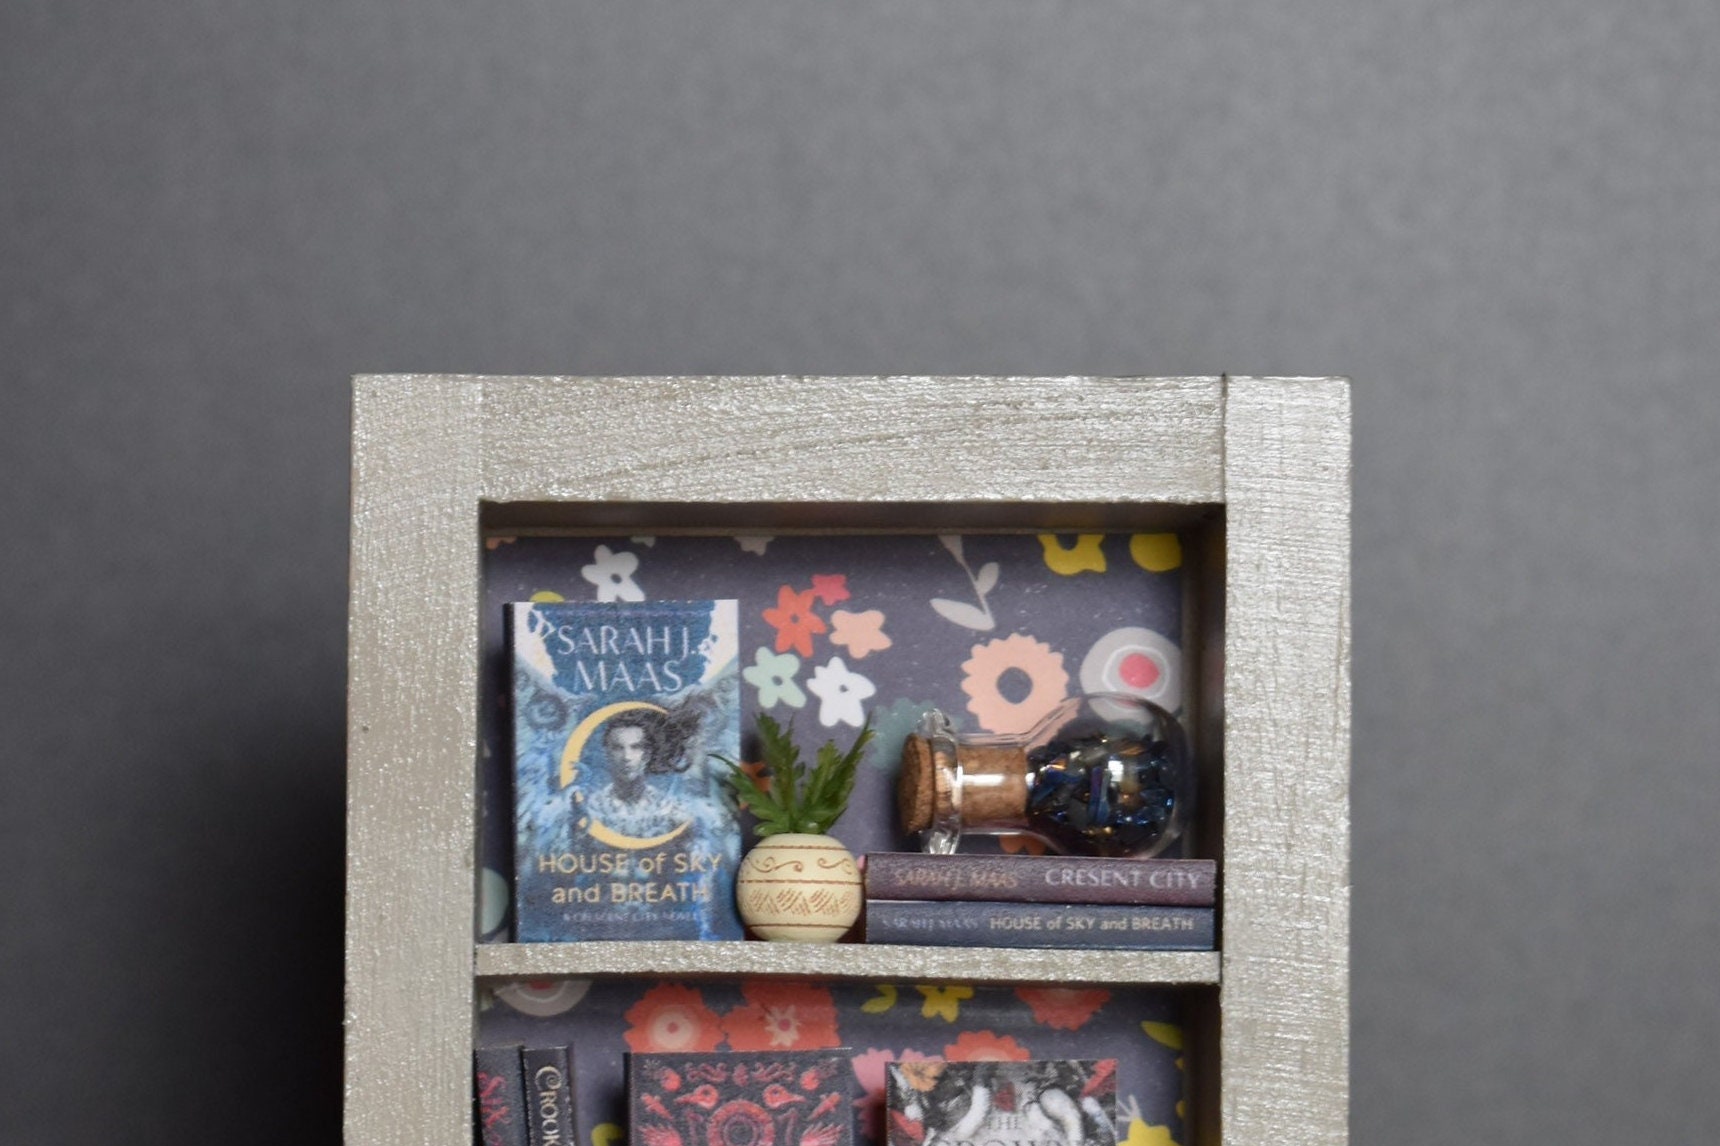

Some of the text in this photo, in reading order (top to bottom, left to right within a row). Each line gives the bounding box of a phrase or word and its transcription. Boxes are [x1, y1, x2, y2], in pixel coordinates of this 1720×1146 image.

[557, 625, 671, 655] SARAH
[573, 660, 682, 693] MAAS
[538, 852, 723, 874] HOUSE of SKY
[1044, 868, 1202, 889] CRESENT CITY
[551, 882, 713, 904] and BREATH
[989, 916, 1195, 931] HOUSE of SKY and BREATH
[477, 1071, 512, 1128] SIX
[987, 1114, 1022, 1131] THE
